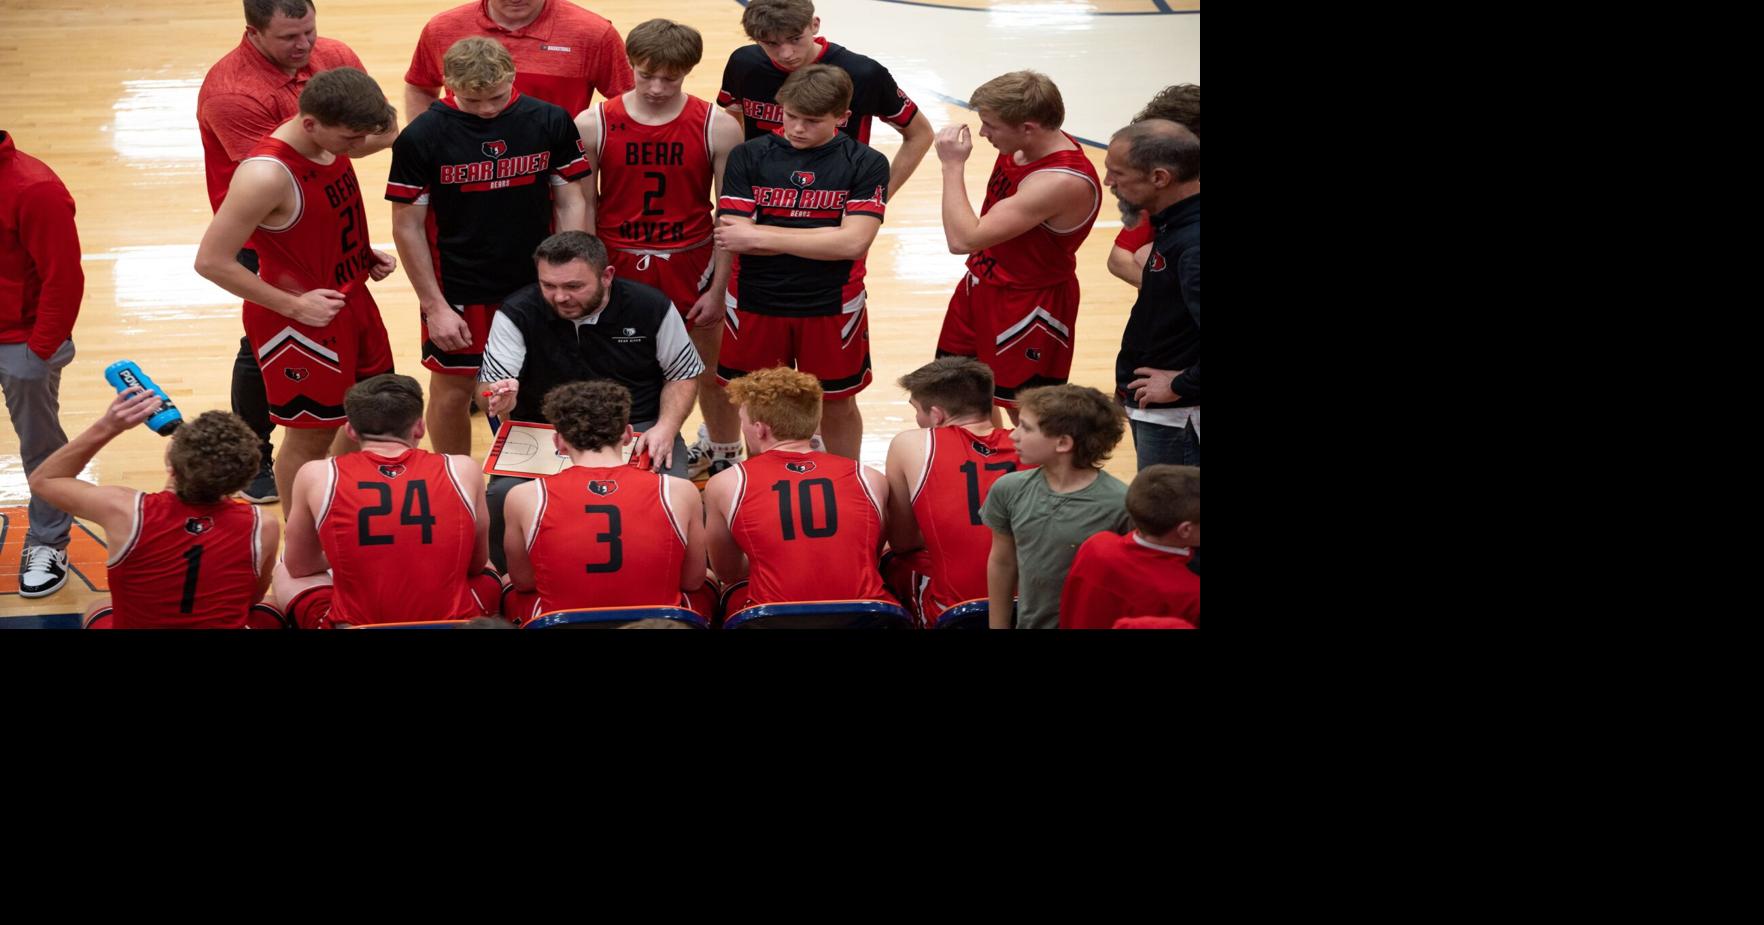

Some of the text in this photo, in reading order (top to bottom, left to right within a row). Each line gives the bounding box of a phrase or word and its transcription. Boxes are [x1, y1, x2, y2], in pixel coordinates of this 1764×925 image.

[440, 151, 551, 184] BEAR RIVER
[625, 141, 684, 166] BEAR
[642, 171, 666, 216] 2
[800, 189, 850, 210] RIVE
[339, 198, 363, 255] 21
[619, 220, 685, 243] RIVER
[357, 479, 436, 546] 24
[772, 477, 838, 540] 10
[585, 504, 623, 574] 3
[179, 544, 204, 614] 1
